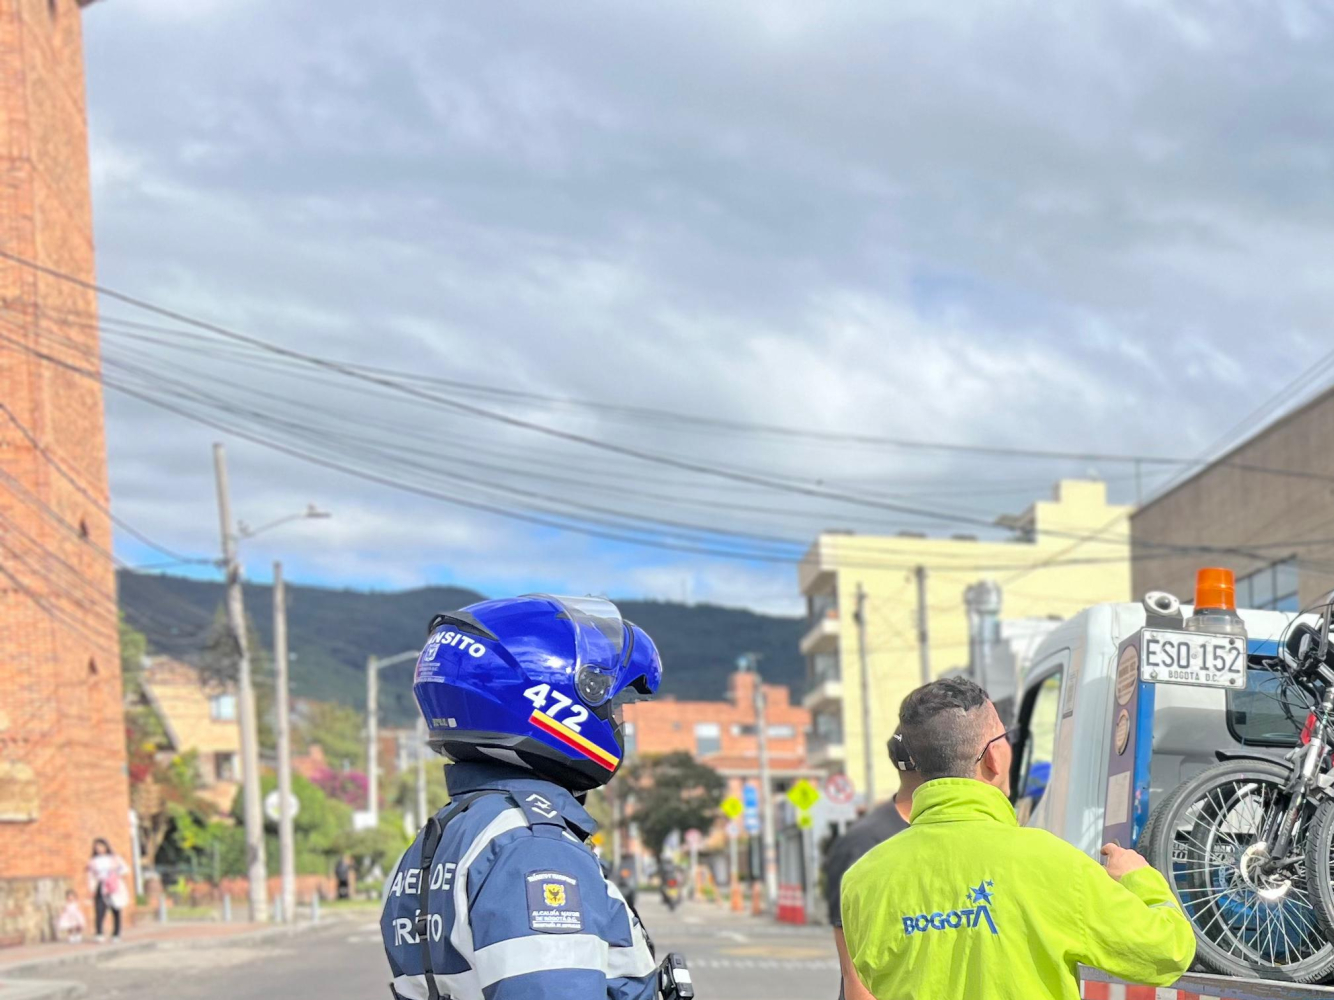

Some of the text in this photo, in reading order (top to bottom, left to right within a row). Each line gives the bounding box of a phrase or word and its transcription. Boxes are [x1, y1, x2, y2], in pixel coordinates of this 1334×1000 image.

[1199, 643, 1240, 674] 152
[1168, 669, 1200, 681] BOGOTA
[523, 683, 588, 733] 472
